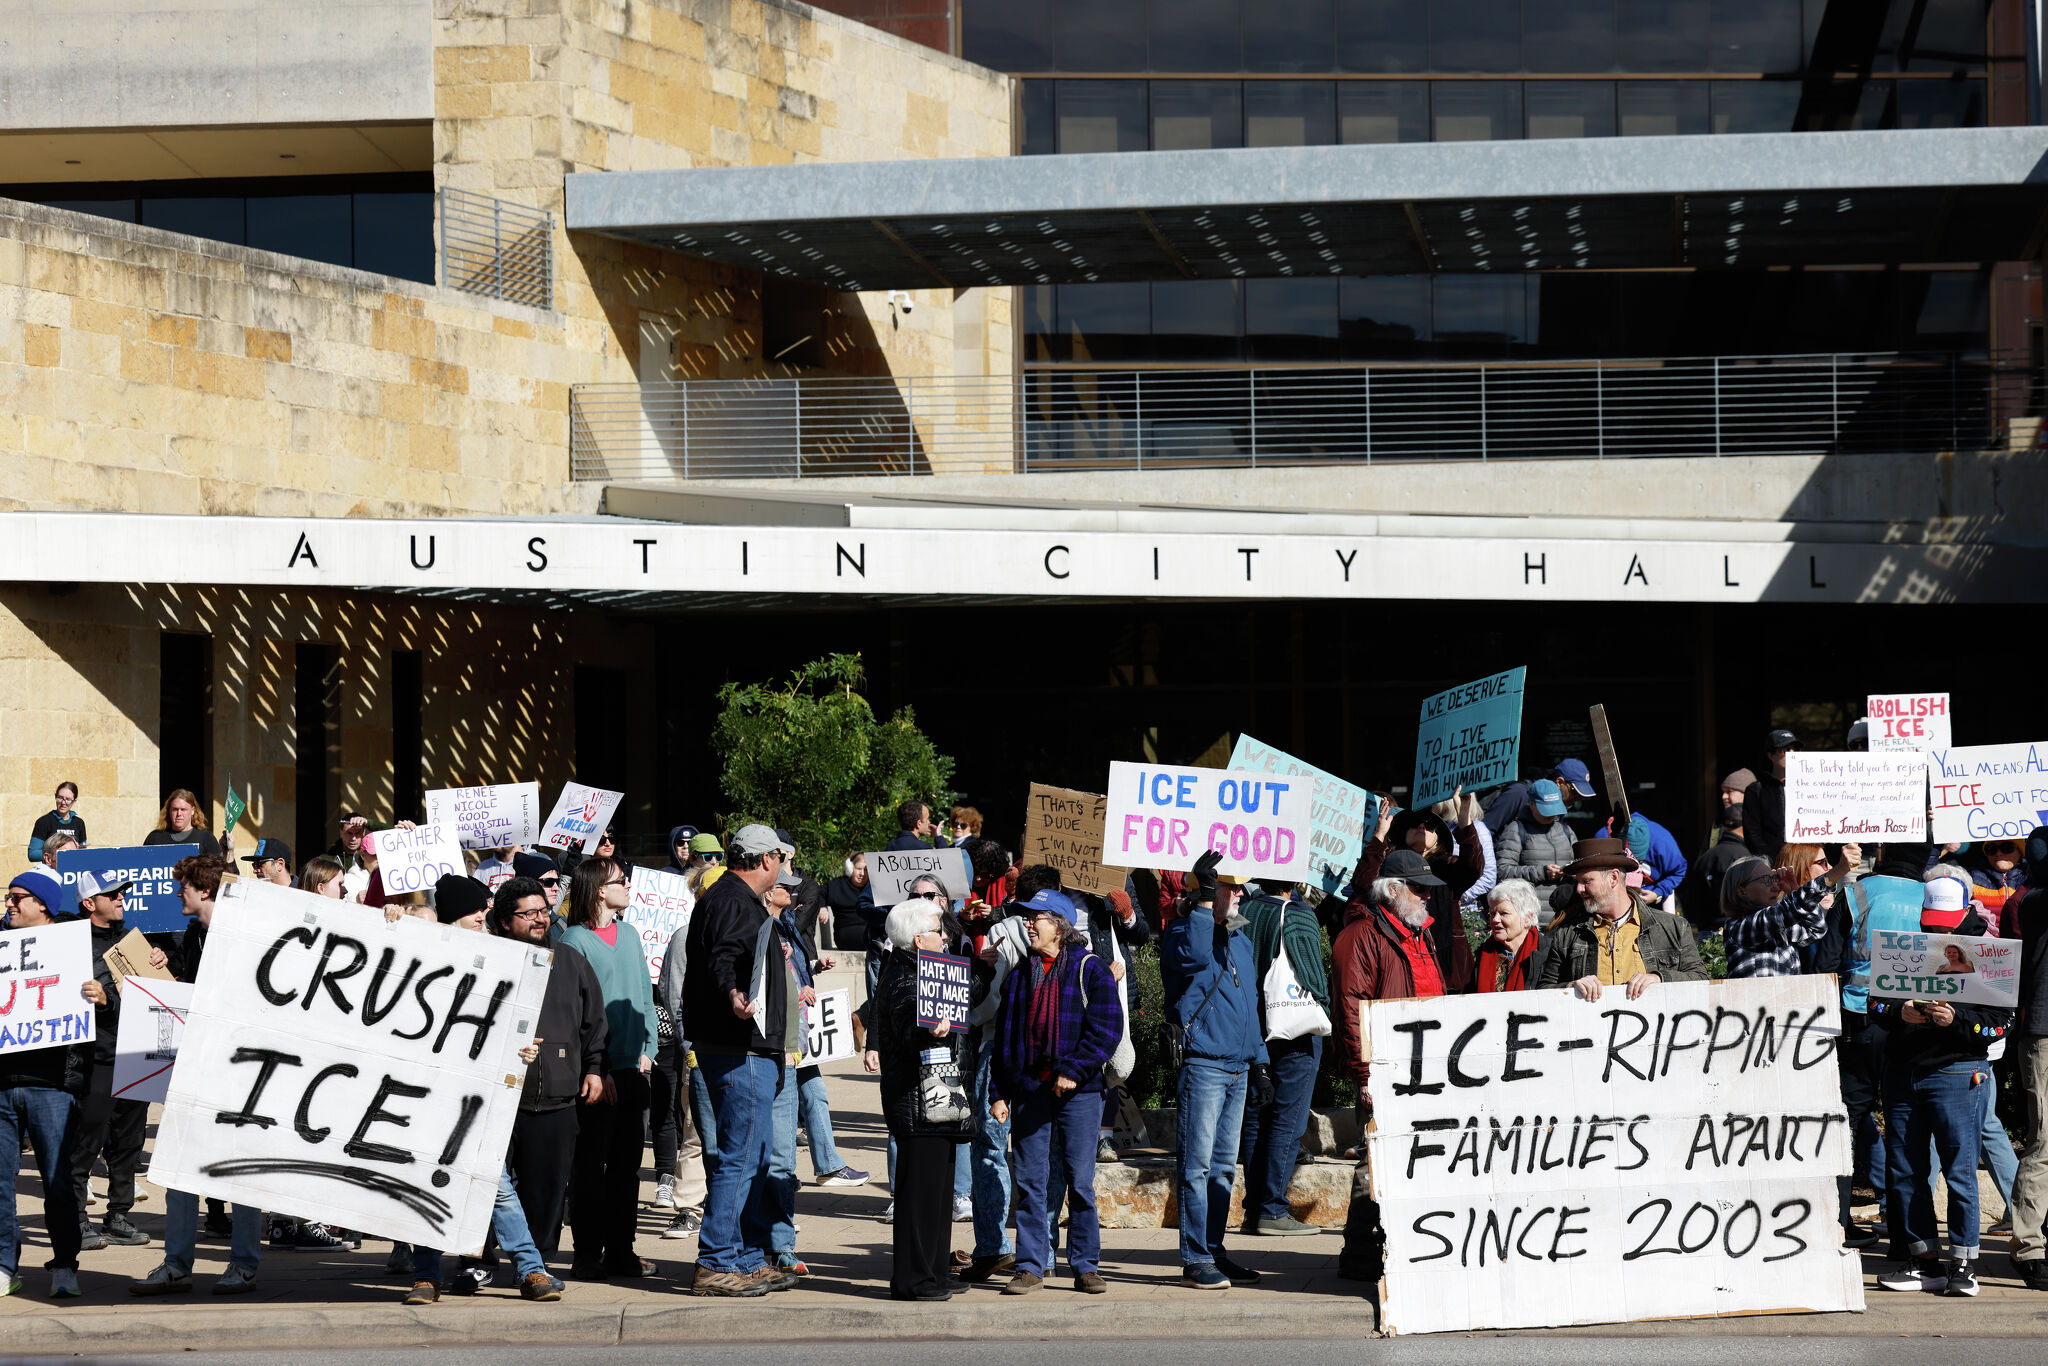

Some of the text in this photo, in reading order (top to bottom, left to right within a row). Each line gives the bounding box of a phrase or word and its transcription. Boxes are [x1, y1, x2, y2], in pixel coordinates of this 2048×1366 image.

[288, 532, 1826, 588] AUSTIN CITY HALL
[1427, 675, 1509, 717] WE DESERVE
[1868, 697, 1945, 718] ABOLISH
[1883, 718, 1924, 738] ICE
[1424, 723, 1487, 758] TO LIVE
[1245, 741, 1280, 774] WE
[1421, 750, 1457, 780] WITH
[1460, 736, 1517, 769] DIGNITY
[1799, 760, 1814, 773] The
[1820, 759, 1843, 776] Party
[1848, 760, 1864, 773] told
[1867, 766, 1880, 776] you
[1897, 763, 1926, 777] reject
[1932, 750, 1969, 778] YALL
[1976, 761, 2023, 776] MEANS
[1417, 758, 1510, 801] AND HUMANITY
[1796, 779, 1810, 787] the
[1813, 779, 1846, 787] evidence
[456, 786, 496, 799] RENEE
[1138, 772, 1289, 815] ICE OUT
[1796, 791, 1803, 799] It
[1822, 791, 1838, 799] their
[1934, 783, 2048, 808] ICE OUT FO
[454, 798, 498, 811] NICOLE
[521, 794, 530, 837] TERROR
[1036, 795, 1083, 815] THAT'S
[456, 818, 512, 831] HOULD STILL
[459, 811, 489, 822] GOOD
[1792, 818, 1833, 838] Arrest
[1837, 816, 1880, 834] Jonathan
[1885, 818, 1908, 833] Ross
[1967, 808, 2036, 839] GOOD
[382, 826, 445, 852] GATHER
[474, 829, 488, 838] BE
[1122, 814, 1296, 865] FOR GOOD
[1311, 830, 1346, 856] AND
[408, 850, 431, 863] FOR
[1037, 835, 1099, 857] I'M NOT
[878, 855, 942, 873] ABOLISH
[1045, 853, 1099, 872] MAD AT
[157, 881, 173, 895] IS
[1073, 872, 1098, 889] YOU
[121, 898, 148, 912] VIL
[635, 893, 688, 912] NEVER
[643, 930, 671, 944] CAU
[1880, 932, 1928, 951] ICE
[920, 960, 969, 984] HATE WILL
[1979, 964, 2014, 979] RENEE
[0, 974, 60, 1016] UT
[256, 926, 513, 1060] CRUSH
[920, 980, 969, 1004] NOT MAKE
[920, 1000, 968, 1023] US GREAT
[0, 1011, 90, 1048] AUSTIN
[808, 1028, 838, 1057] UT
[1393, 1006, 1836, 1095] ICE-RIPPING
[215, 1047, 483, 1188] ICE!
[1407, 1113, 1846, 1178] FAMILIES APART
[1410, 1198, 1811, 1267] SINCE 2003
